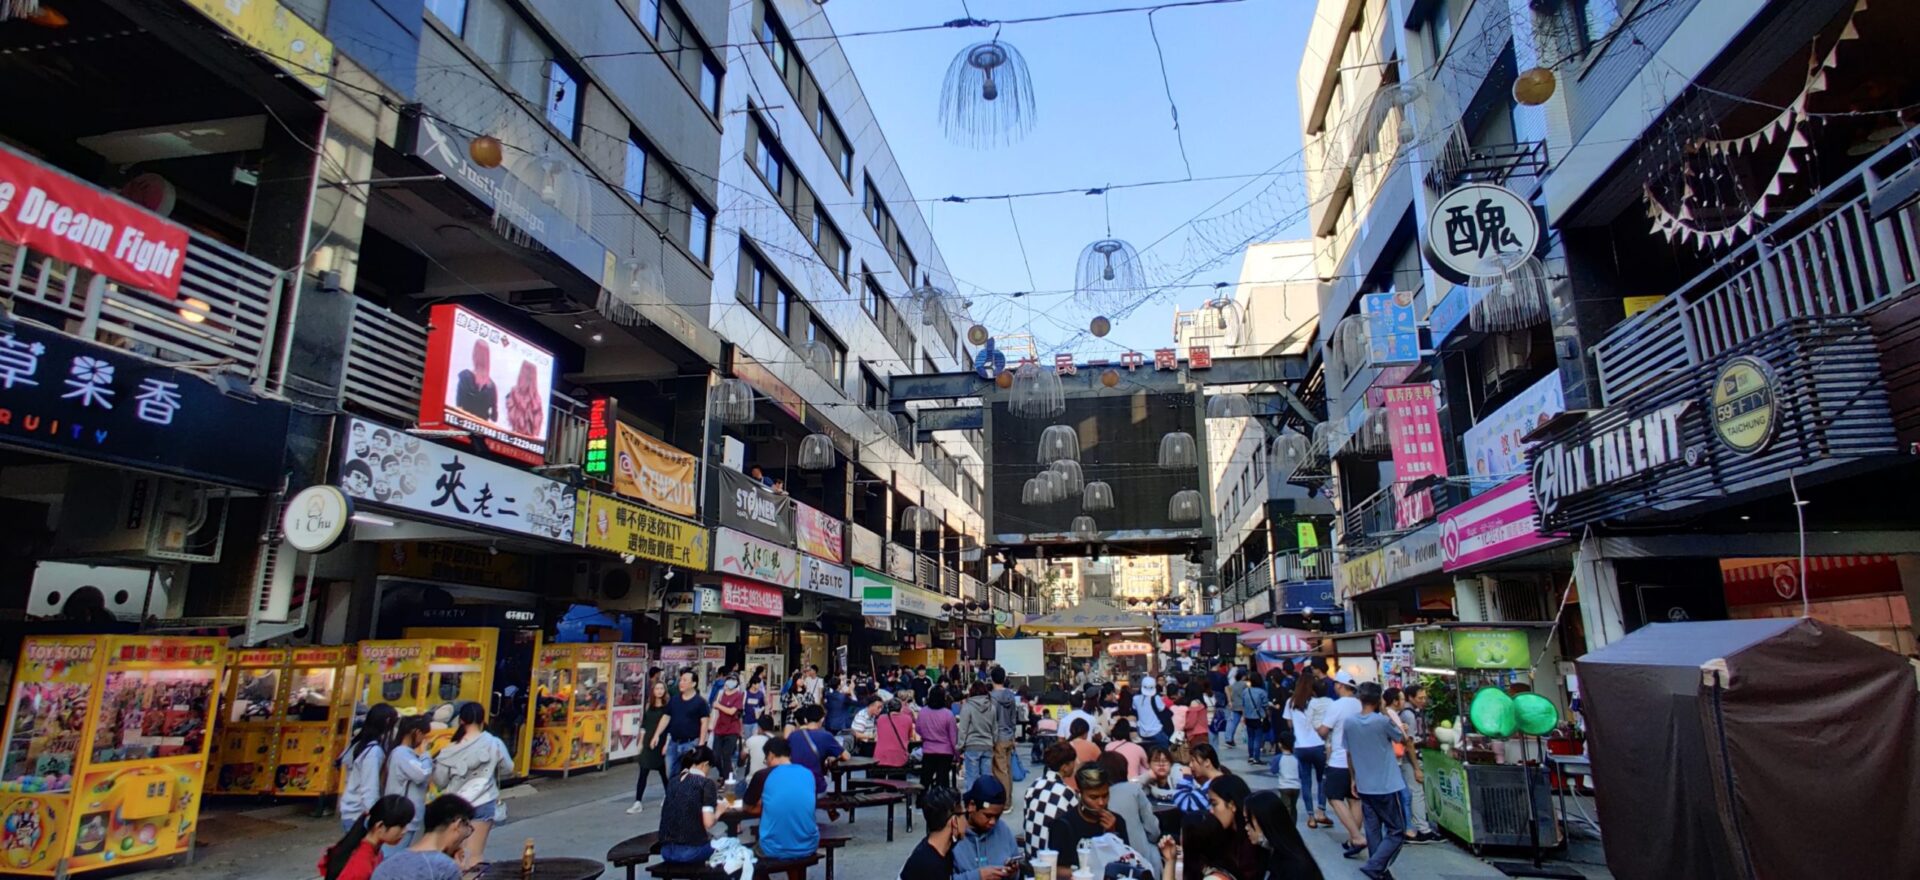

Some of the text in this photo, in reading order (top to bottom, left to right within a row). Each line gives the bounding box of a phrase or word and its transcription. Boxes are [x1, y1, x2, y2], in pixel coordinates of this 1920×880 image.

[17, 187, 113, 253] Dream
[115, 227, 180, 279] Fight
[1445, 198, 1523, 259] 醜
[1590, 402, 1686, 484] TALENT
[1727, 416, 1766, 436] TAICHUNG
[431, 455, 520, 518] 夾老二
[306, 516, 332, 533] Chu
[29, 645, 97, 661] TOY STORY
[386, 646, 420, 657] STORY
